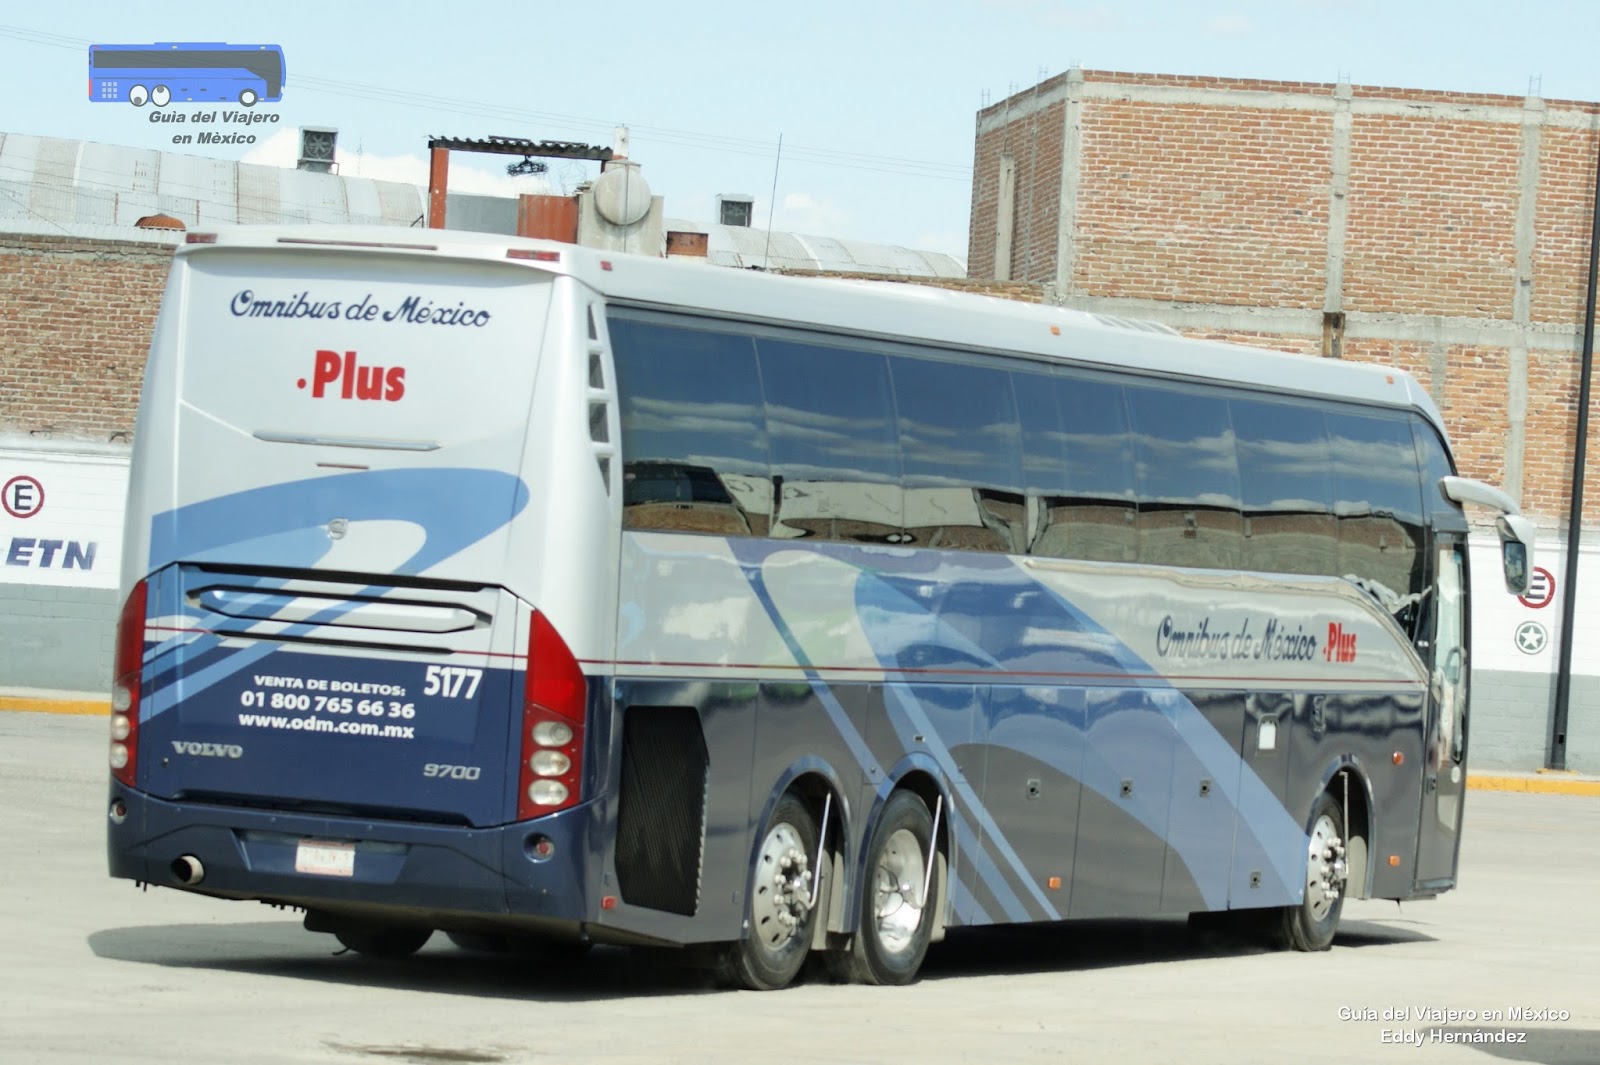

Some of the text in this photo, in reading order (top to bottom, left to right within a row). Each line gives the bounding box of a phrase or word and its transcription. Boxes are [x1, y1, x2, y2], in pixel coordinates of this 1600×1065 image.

[230, 289, 491, 327] Omnibus de México
[14, 484, 33, 510] E
[5, 537, 98, 570] ETN
[1156, 615, 1317, 661] Omnibus de México
[254, 675, 406, 696] VENTA DE BOLETOS:
[423, 665, 483, 699] 5177
[240, 691, 415, 719] 01 800 765 66 36
[238, 713, 415, 739] www.odm.com.mx
[171, 741, 244, 759] VOLVO
[423, 763, 481, 781] 9700
